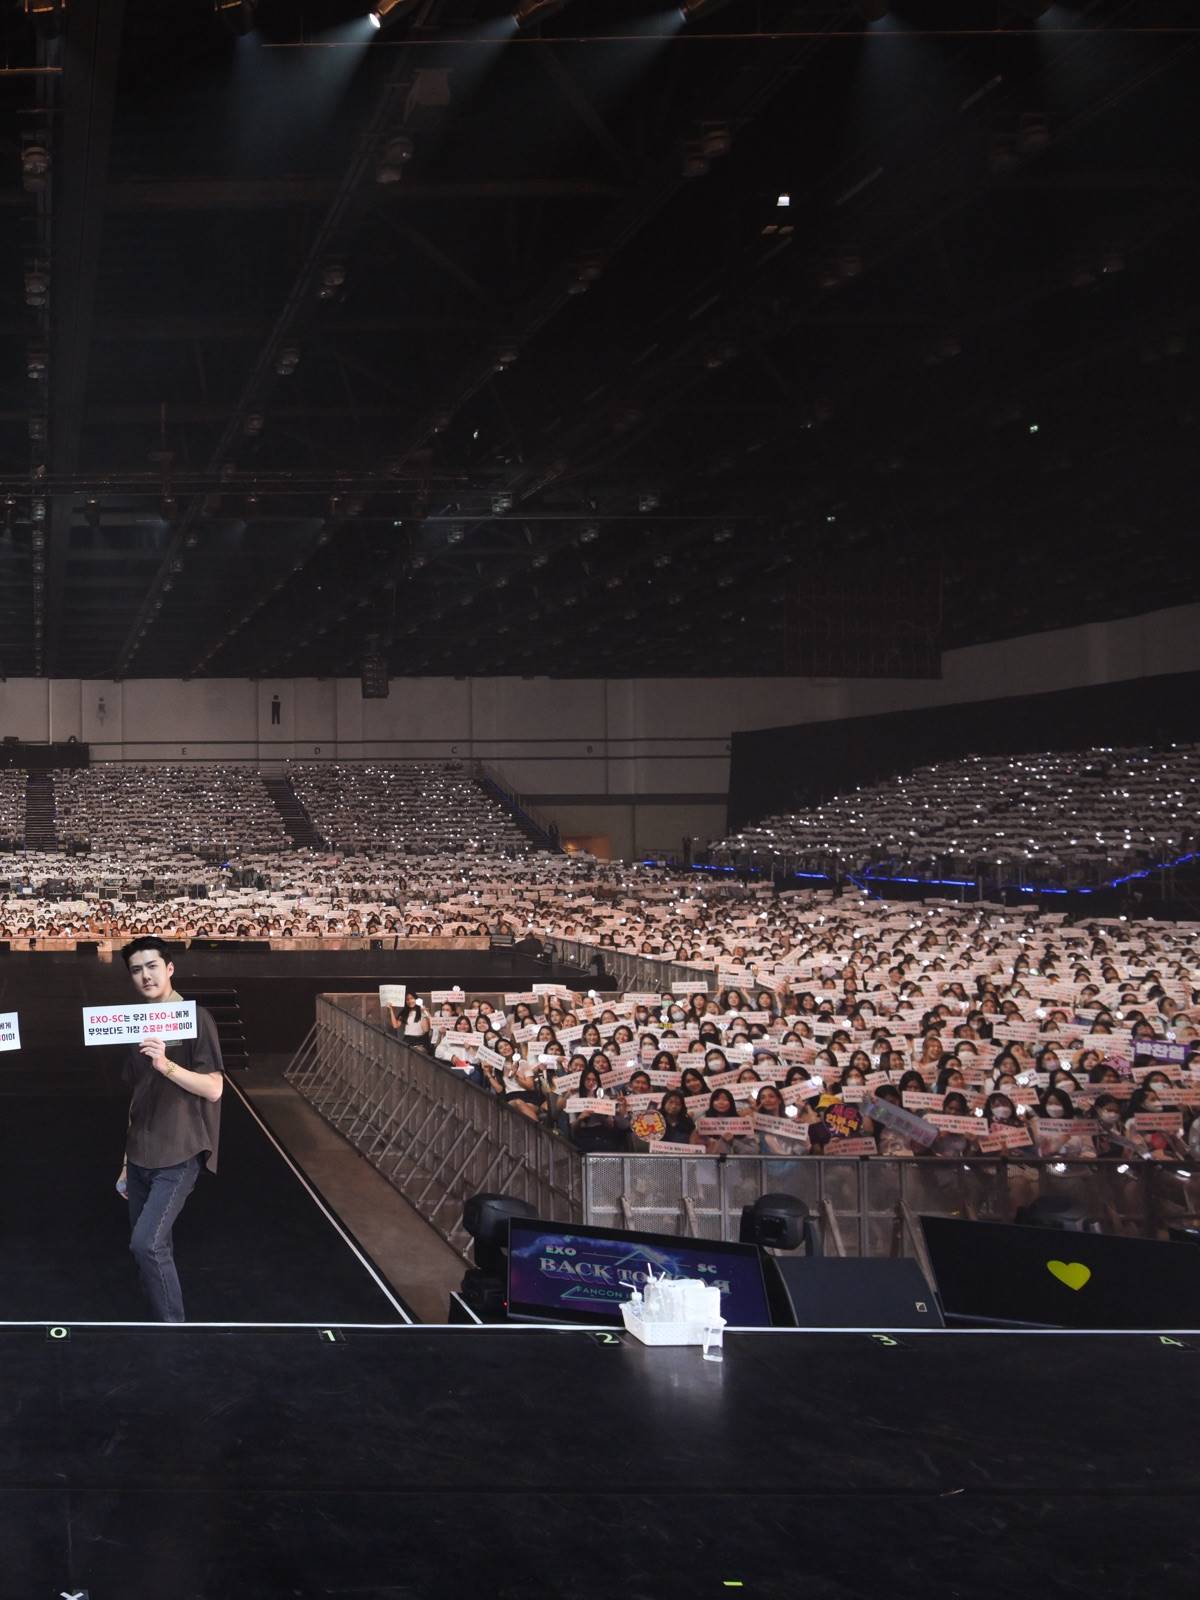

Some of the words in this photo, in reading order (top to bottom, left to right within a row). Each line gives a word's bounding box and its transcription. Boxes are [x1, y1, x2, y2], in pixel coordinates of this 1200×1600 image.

[181, 747, 188, 756] E
[451, 746, 457, 754] C
[90, 1014, 131, 1024] EXO-SC는
[133, 1013, 147, 1021] 우리
[149, 1010, 189, 1020] EXO-L에게
[88, 1026, 124, 1036] 무엇보다도
[126, 1025, 140, 1034] 가장
[142, 1024, 163, 1033] 소중한
[545, 1246, 576, 1256] EXO
[697, 1264, 717, 1274] SC
[540, 1257, 613, 1279] BACK
[577, 1285, 623, 1297] FANCON
[322, 1330, 336, 1342] 1
[596, 1332, 620, 1344] 2
[871, 1334, 898, 1346] 3
